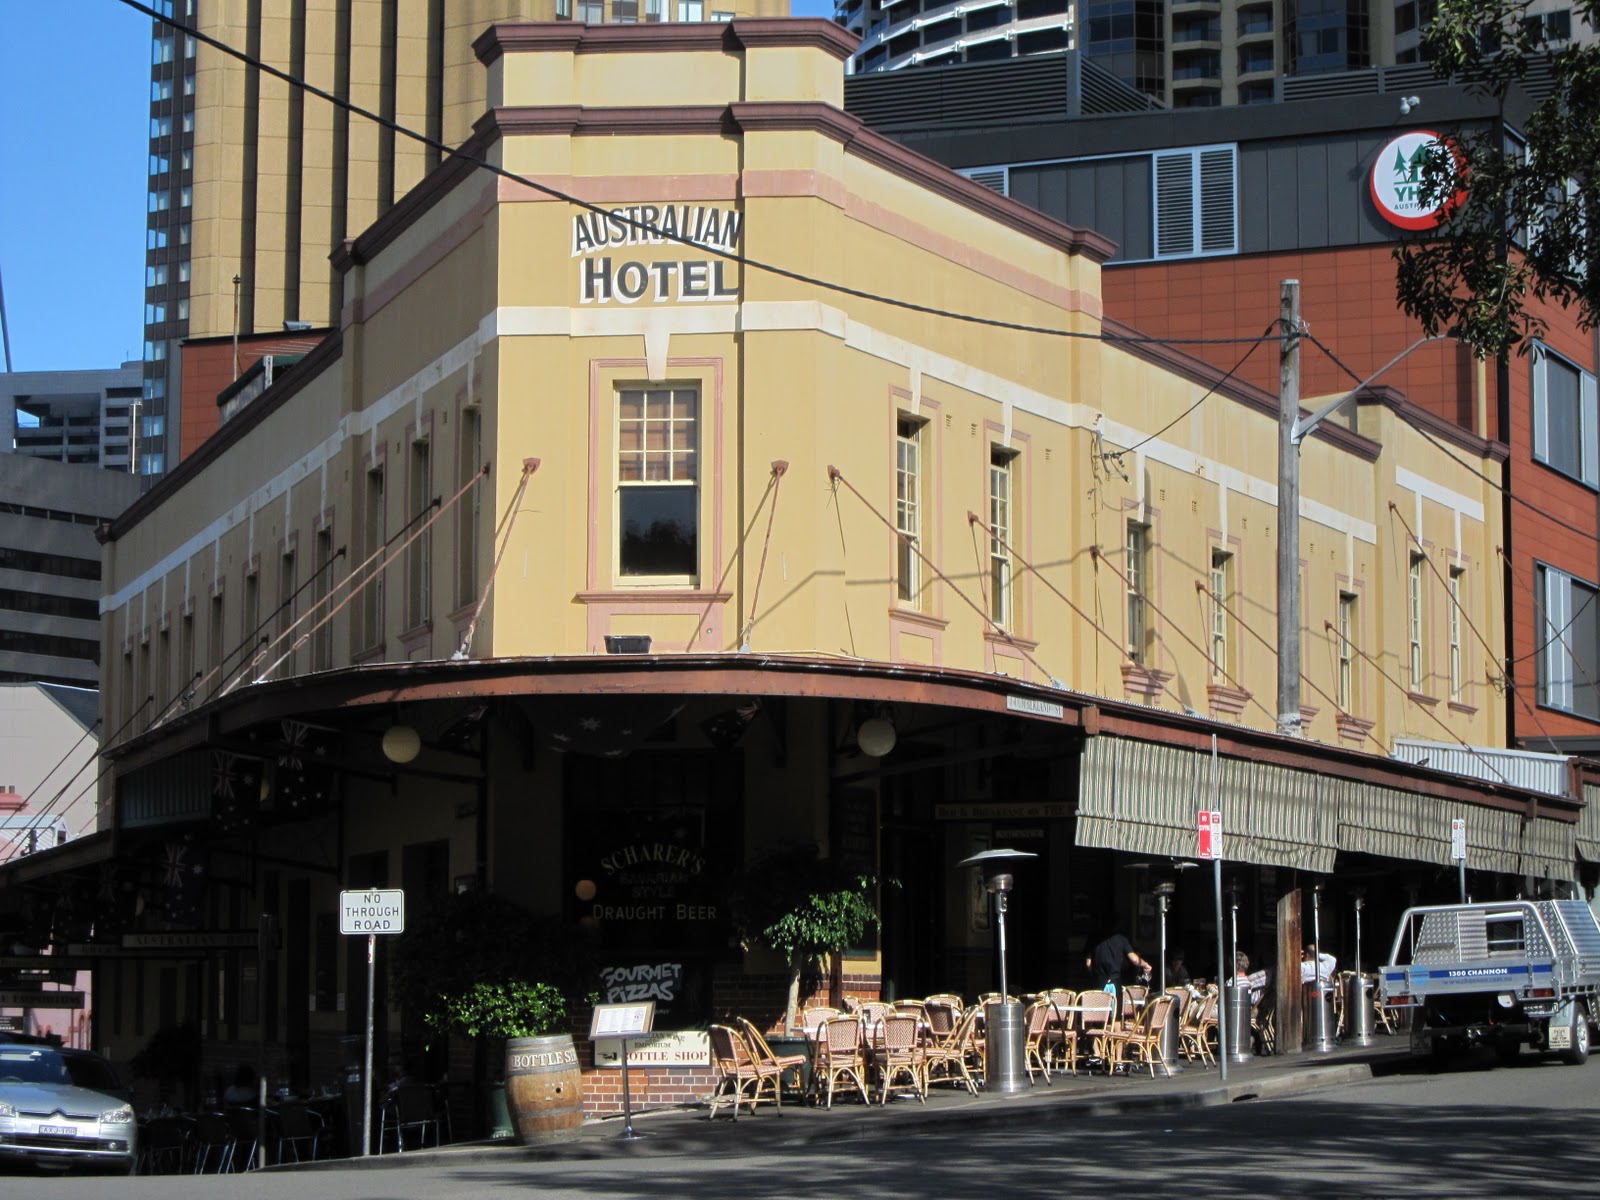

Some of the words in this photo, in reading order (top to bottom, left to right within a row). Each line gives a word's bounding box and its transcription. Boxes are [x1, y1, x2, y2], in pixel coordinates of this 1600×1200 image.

[1394, 185, 1434, 202] YH
[571, 204, 743, 257] AUSTRALIAN
[579, 256, 738, 304] HOTEL
[601, 842, 705, 876] SCHARER'S
[363, 894, 381, 904] NO
[346, 907, 399, 917] THROUGH
[593, 903, 666, 920] DRAUGHT
[676, 903, 717, 920] BEER
[354, 920, 391, 930] ROAD
[600, 962, 682, 988] GOURMET
[1449, 970, 1466, 978] 1300
[1467, 967, 1508, 976] CHANNON
[513, 1051, 563, 1068] BOTTLE
[624, 1051, 668, 1061] OTTLE
[674, 1051, 708, 1061] SHOP
